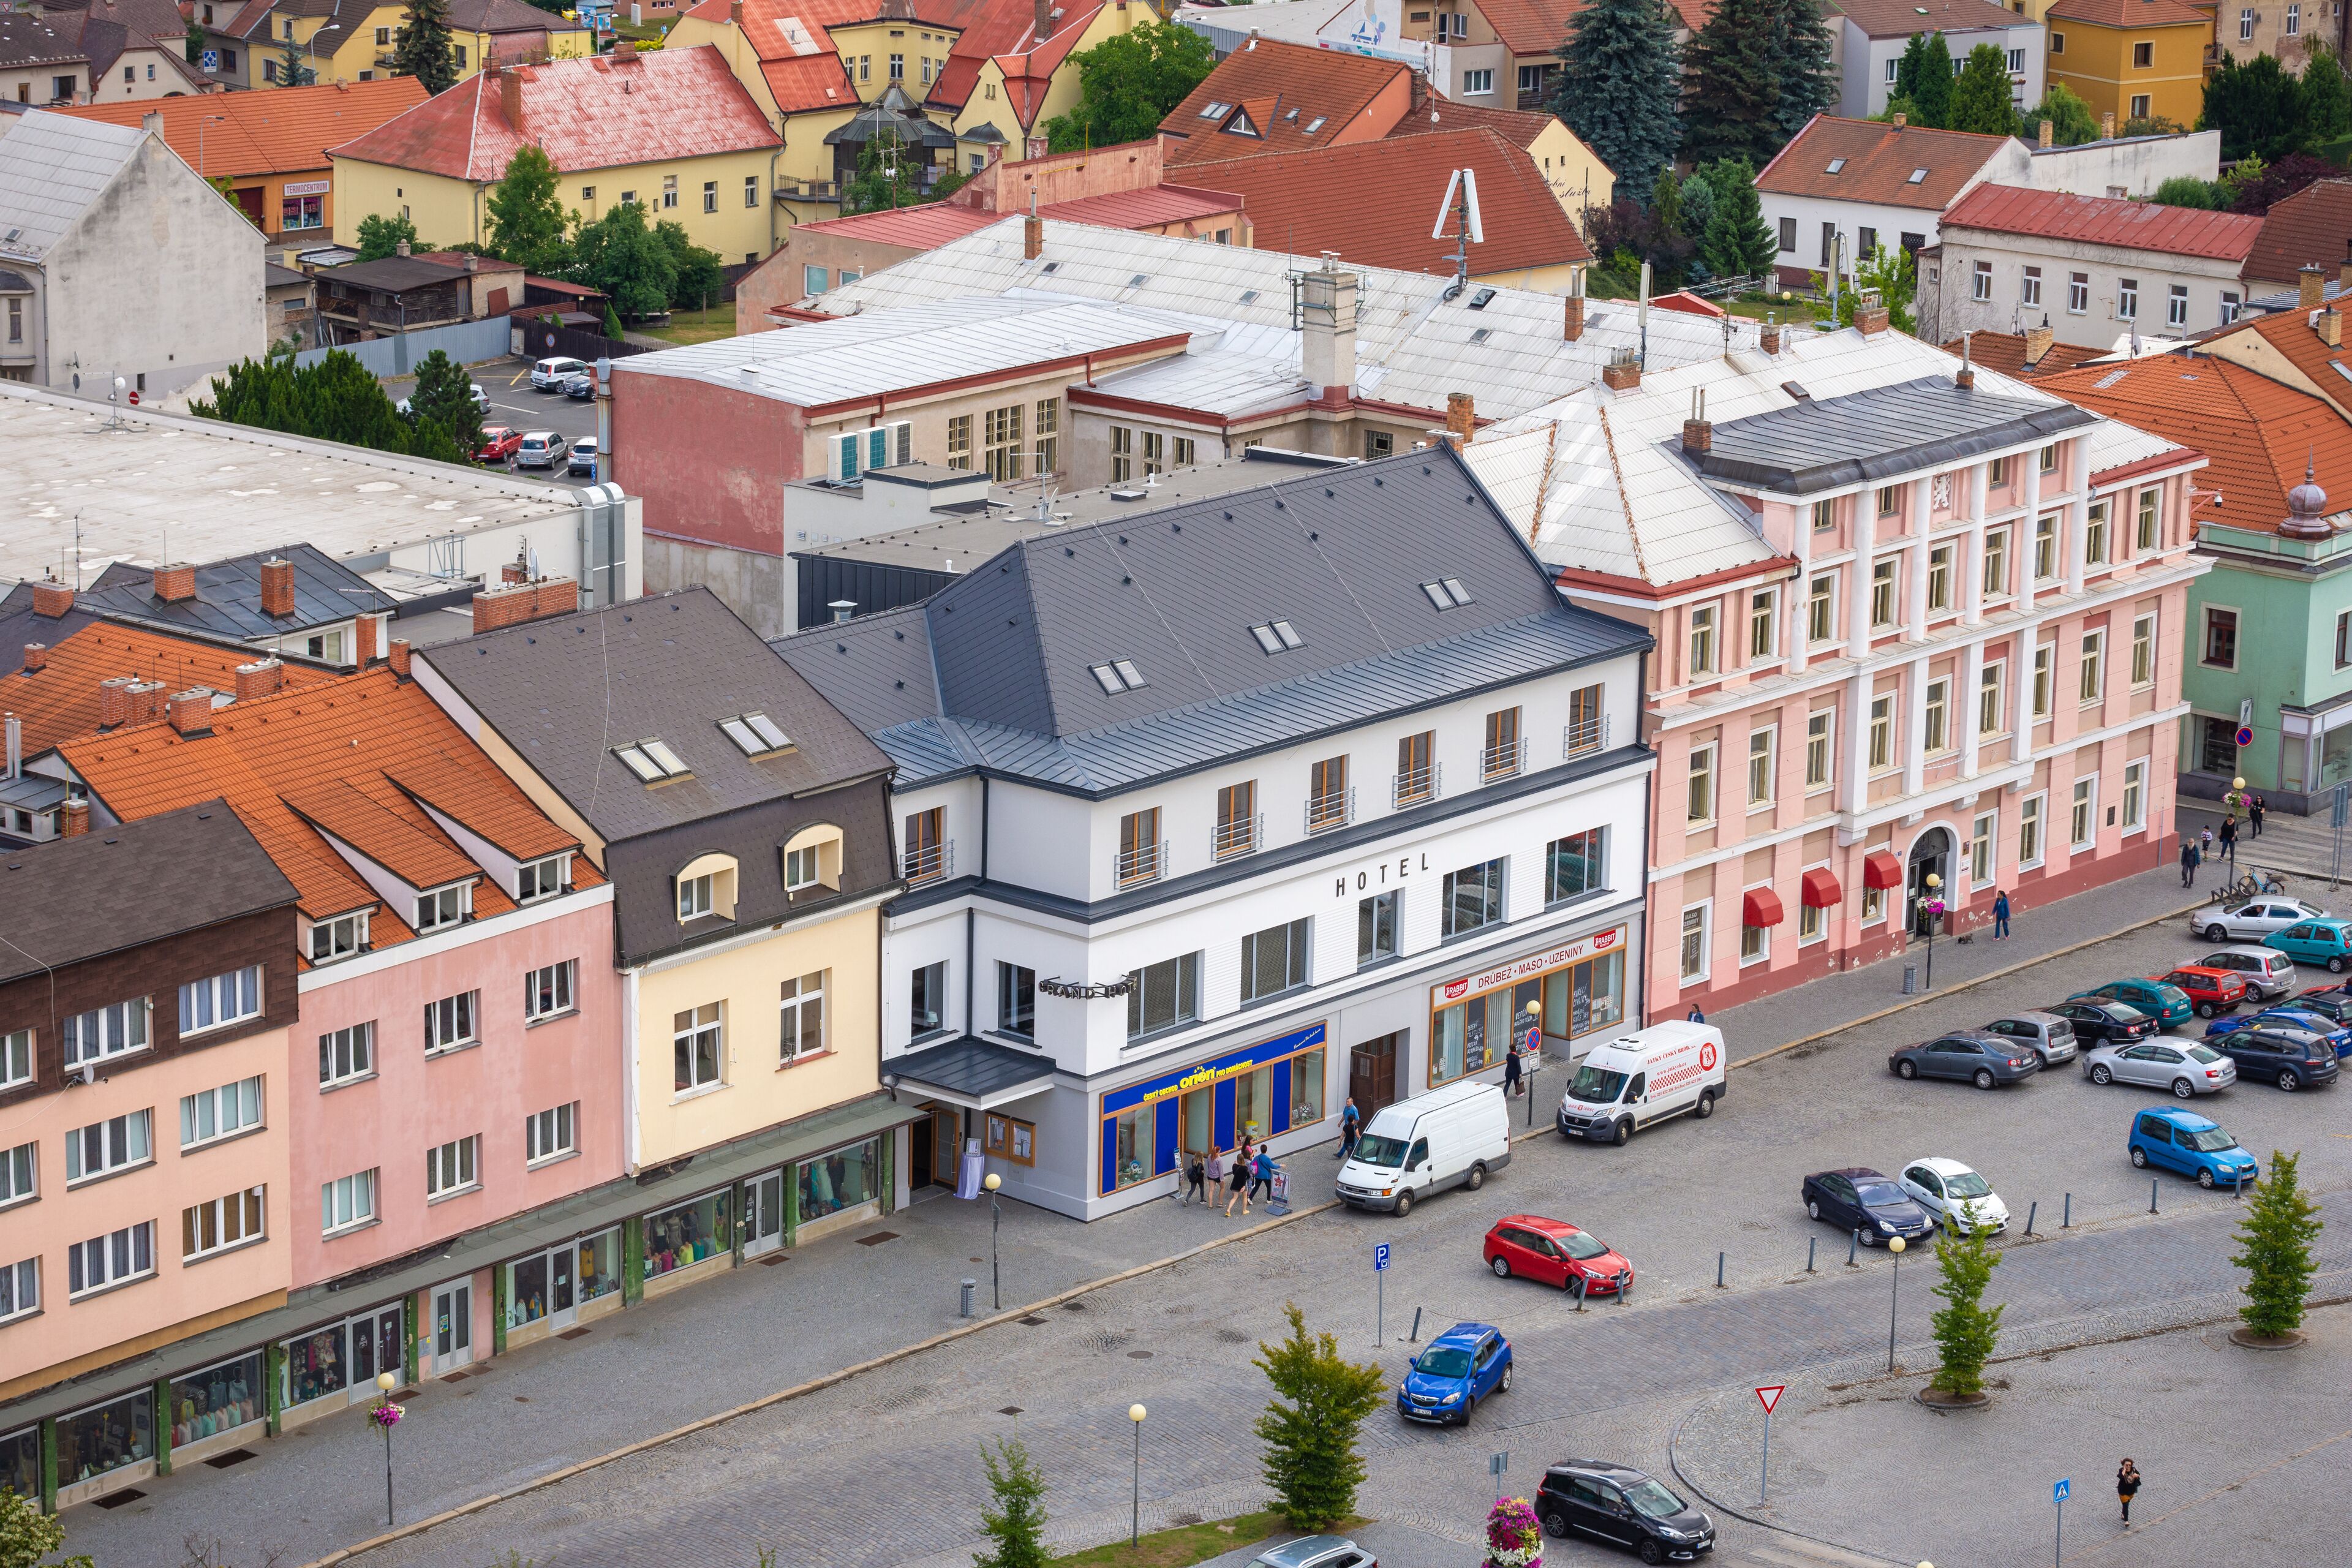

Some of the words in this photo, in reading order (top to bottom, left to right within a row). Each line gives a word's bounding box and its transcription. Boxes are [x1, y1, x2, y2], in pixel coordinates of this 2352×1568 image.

[286, 183, 328, 194] TERMOCENTRUM
[1559, 187, 1591, 198] služba
[1336, 853, 1428, 897] HOTEL
[1683, 918, 1699, 927] ZENINY
[1597, 932, 1616, 945] RABBIT
[1478, 966, 1512, 988] DRŮBEŽ
[1518, 959, 1543, 975] MASO
[1549, 944, 1584, 965] UZENINY
[1039, 981, 1095, 1000] GRAND
[1104, 976, 1137, 999] HOT
[1449, 981, 1468, 994] RABBIT
[1647, 1055, 1662, 1065] JATKY
[1663, 1050, 1677, 1058] ČESKÝ
[1143, 1088, 1159, 1101] ČESKÝ
[1159, 1084, 1178, 1096] OBCHOD
[1179, 1068, 1215, 1088] orion
[1216, 1069, 1226, 1077] PRO
[1226, 1059, 1253, 1074] DOMÁCNOST
[1378, 1247, 1386, 1263] P
